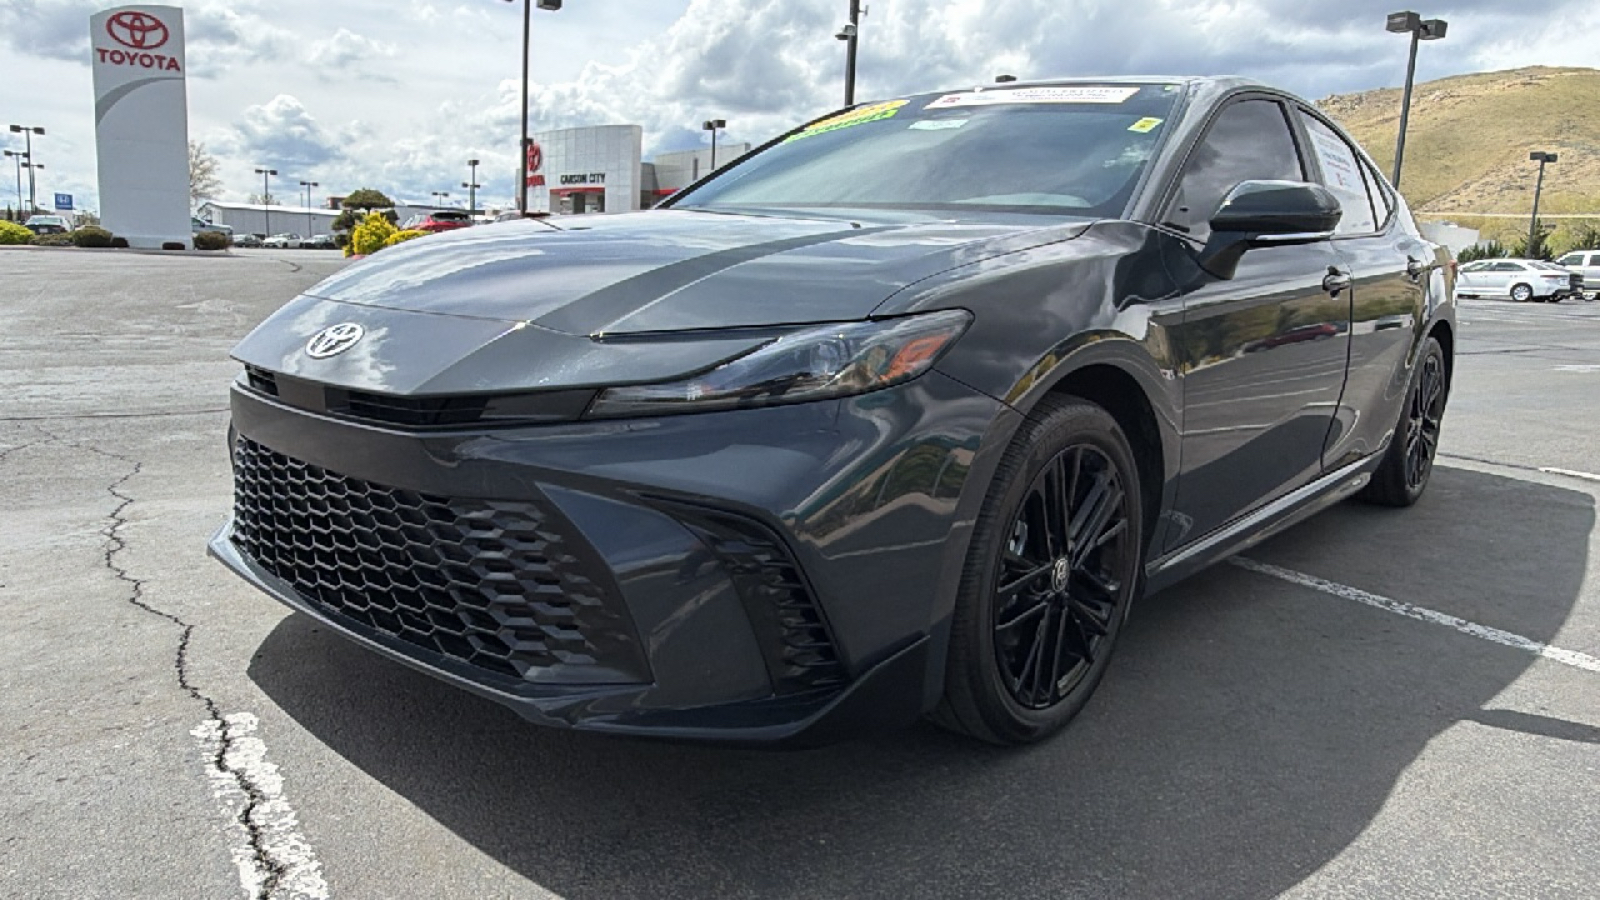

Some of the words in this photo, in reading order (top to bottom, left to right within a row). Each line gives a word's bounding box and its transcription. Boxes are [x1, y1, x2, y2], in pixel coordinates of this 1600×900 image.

[95, 47, 181, 71] TOYOTA
[560, 174, 587, 185] CARSON
[589, 172, 606, 184] CITY
